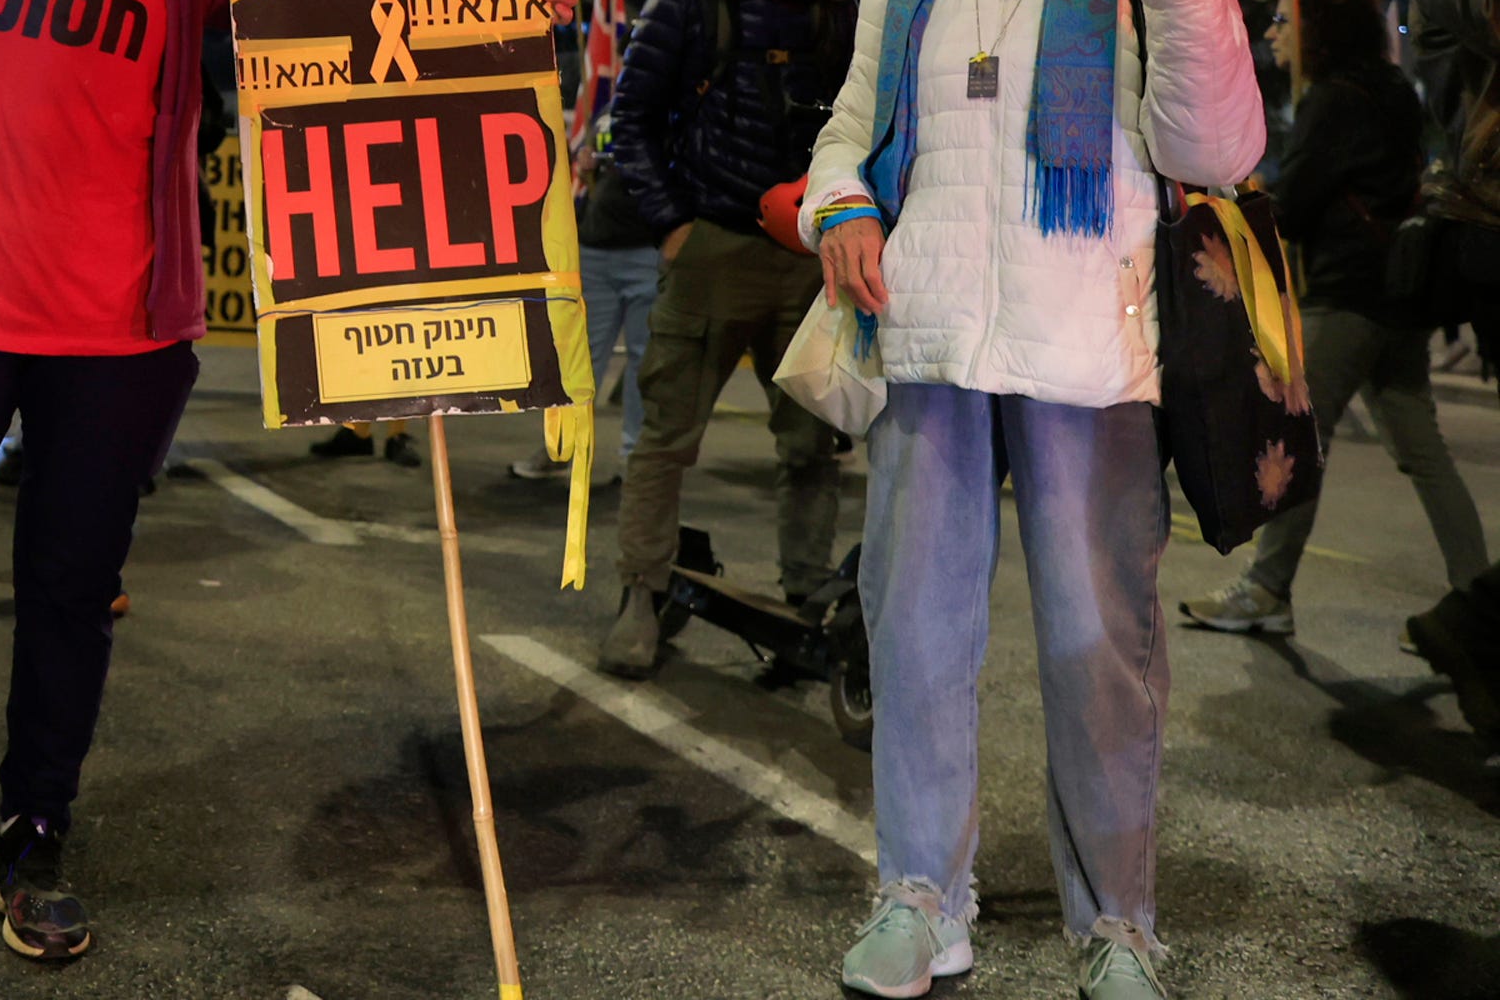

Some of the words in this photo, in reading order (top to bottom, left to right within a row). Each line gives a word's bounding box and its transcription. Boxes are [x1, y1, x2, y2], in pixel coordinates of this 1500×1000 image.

[239, 56, 351, 91] אמא!!!
[261, 111, 550, 281] HELP
[344, 320, 415, 356] חטוף
[425, 314, 497, 350] תינוק
[391, 353, 466, 383] בעזה
